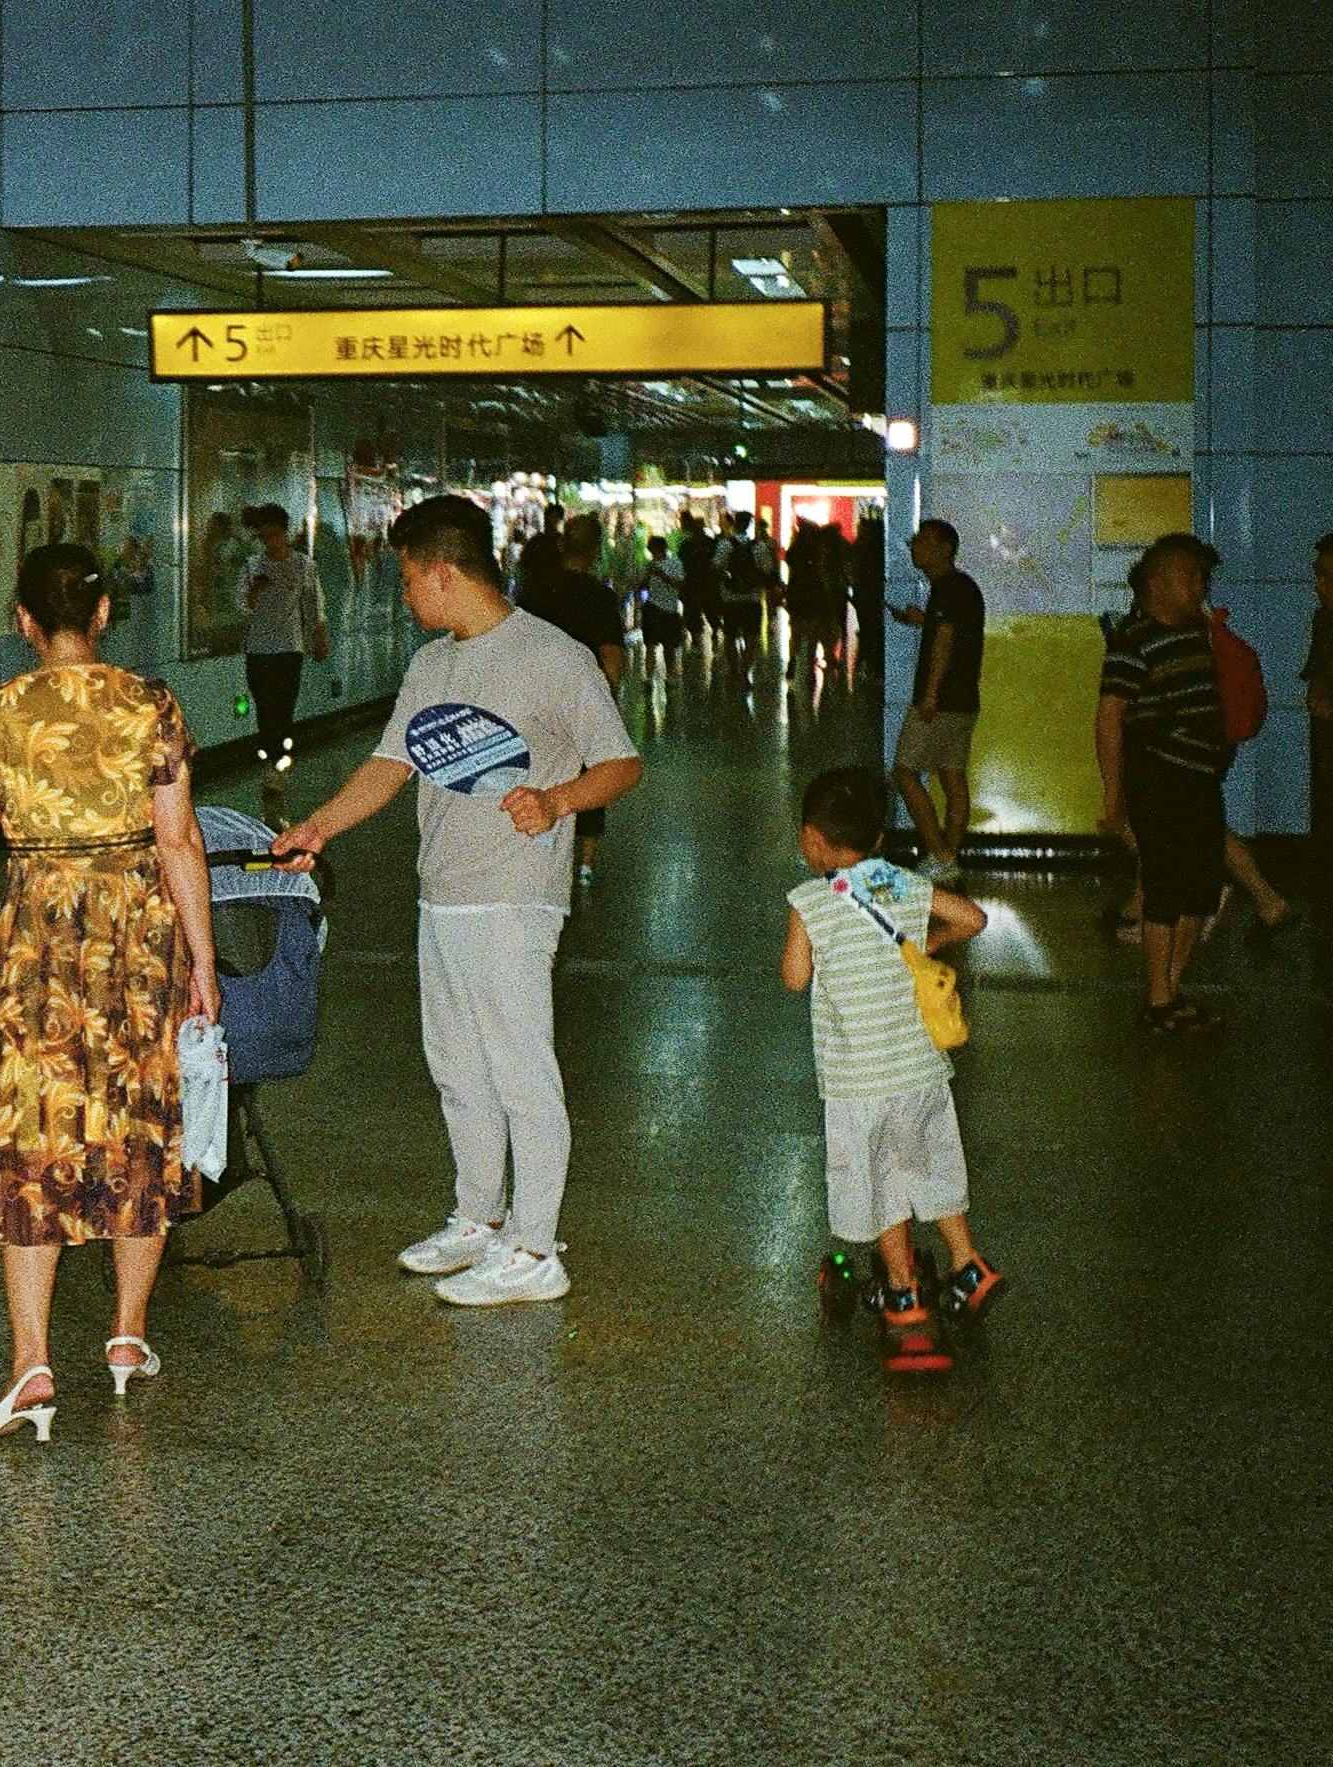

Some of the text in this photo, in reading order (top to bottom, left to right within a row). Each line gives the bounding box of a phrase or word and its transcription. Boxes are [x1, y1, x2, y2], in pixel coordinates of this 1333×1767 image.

[1034, 264, 1122, 306] 出口
[962, 265, 1019, 360] 5
[225, 324, 249, 362] 5
[334, 332, 546, 361] 重庆星光时代广场
